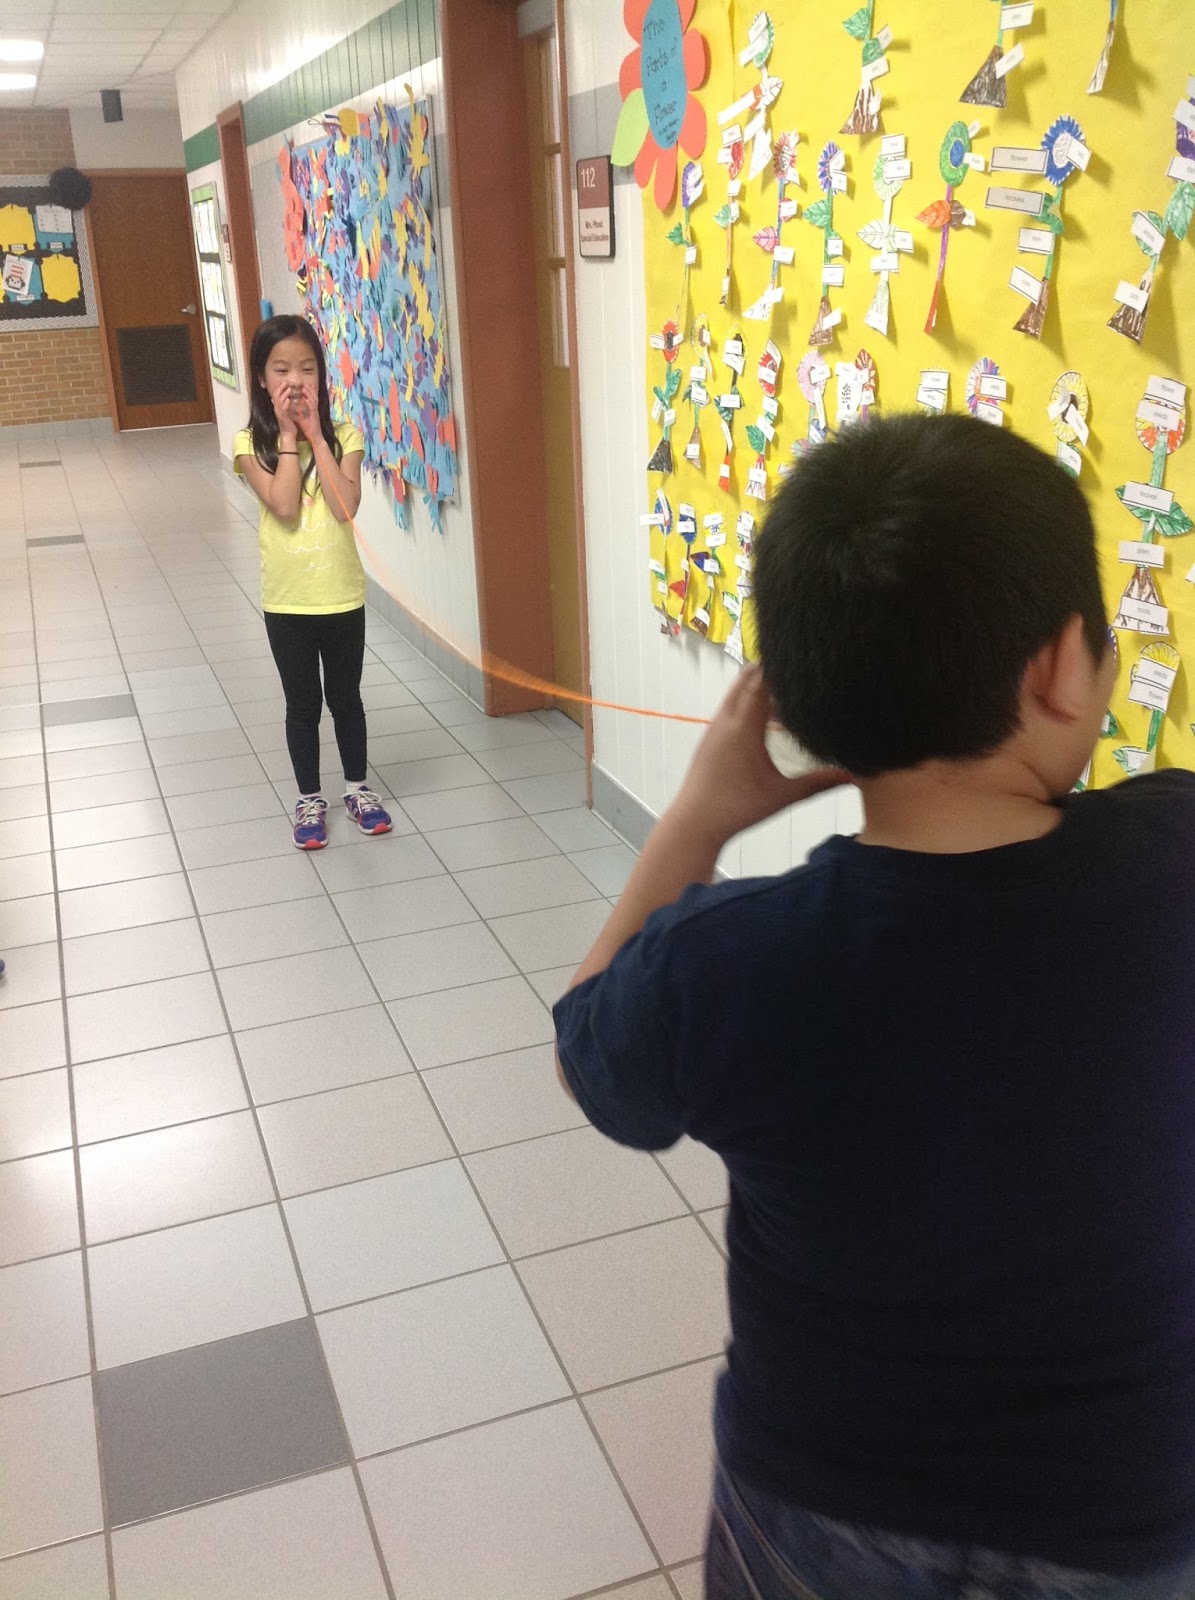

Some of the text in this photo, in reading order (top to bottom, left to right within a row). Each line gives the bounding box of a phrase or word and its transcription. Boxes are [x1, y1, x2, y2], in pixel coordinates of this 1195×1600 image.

[643, 17, 666, 40] The
[646, 48, 669, 76] Parts
[654, 101, 678, 126] Flower
[581, 167, 596, 188] 112
